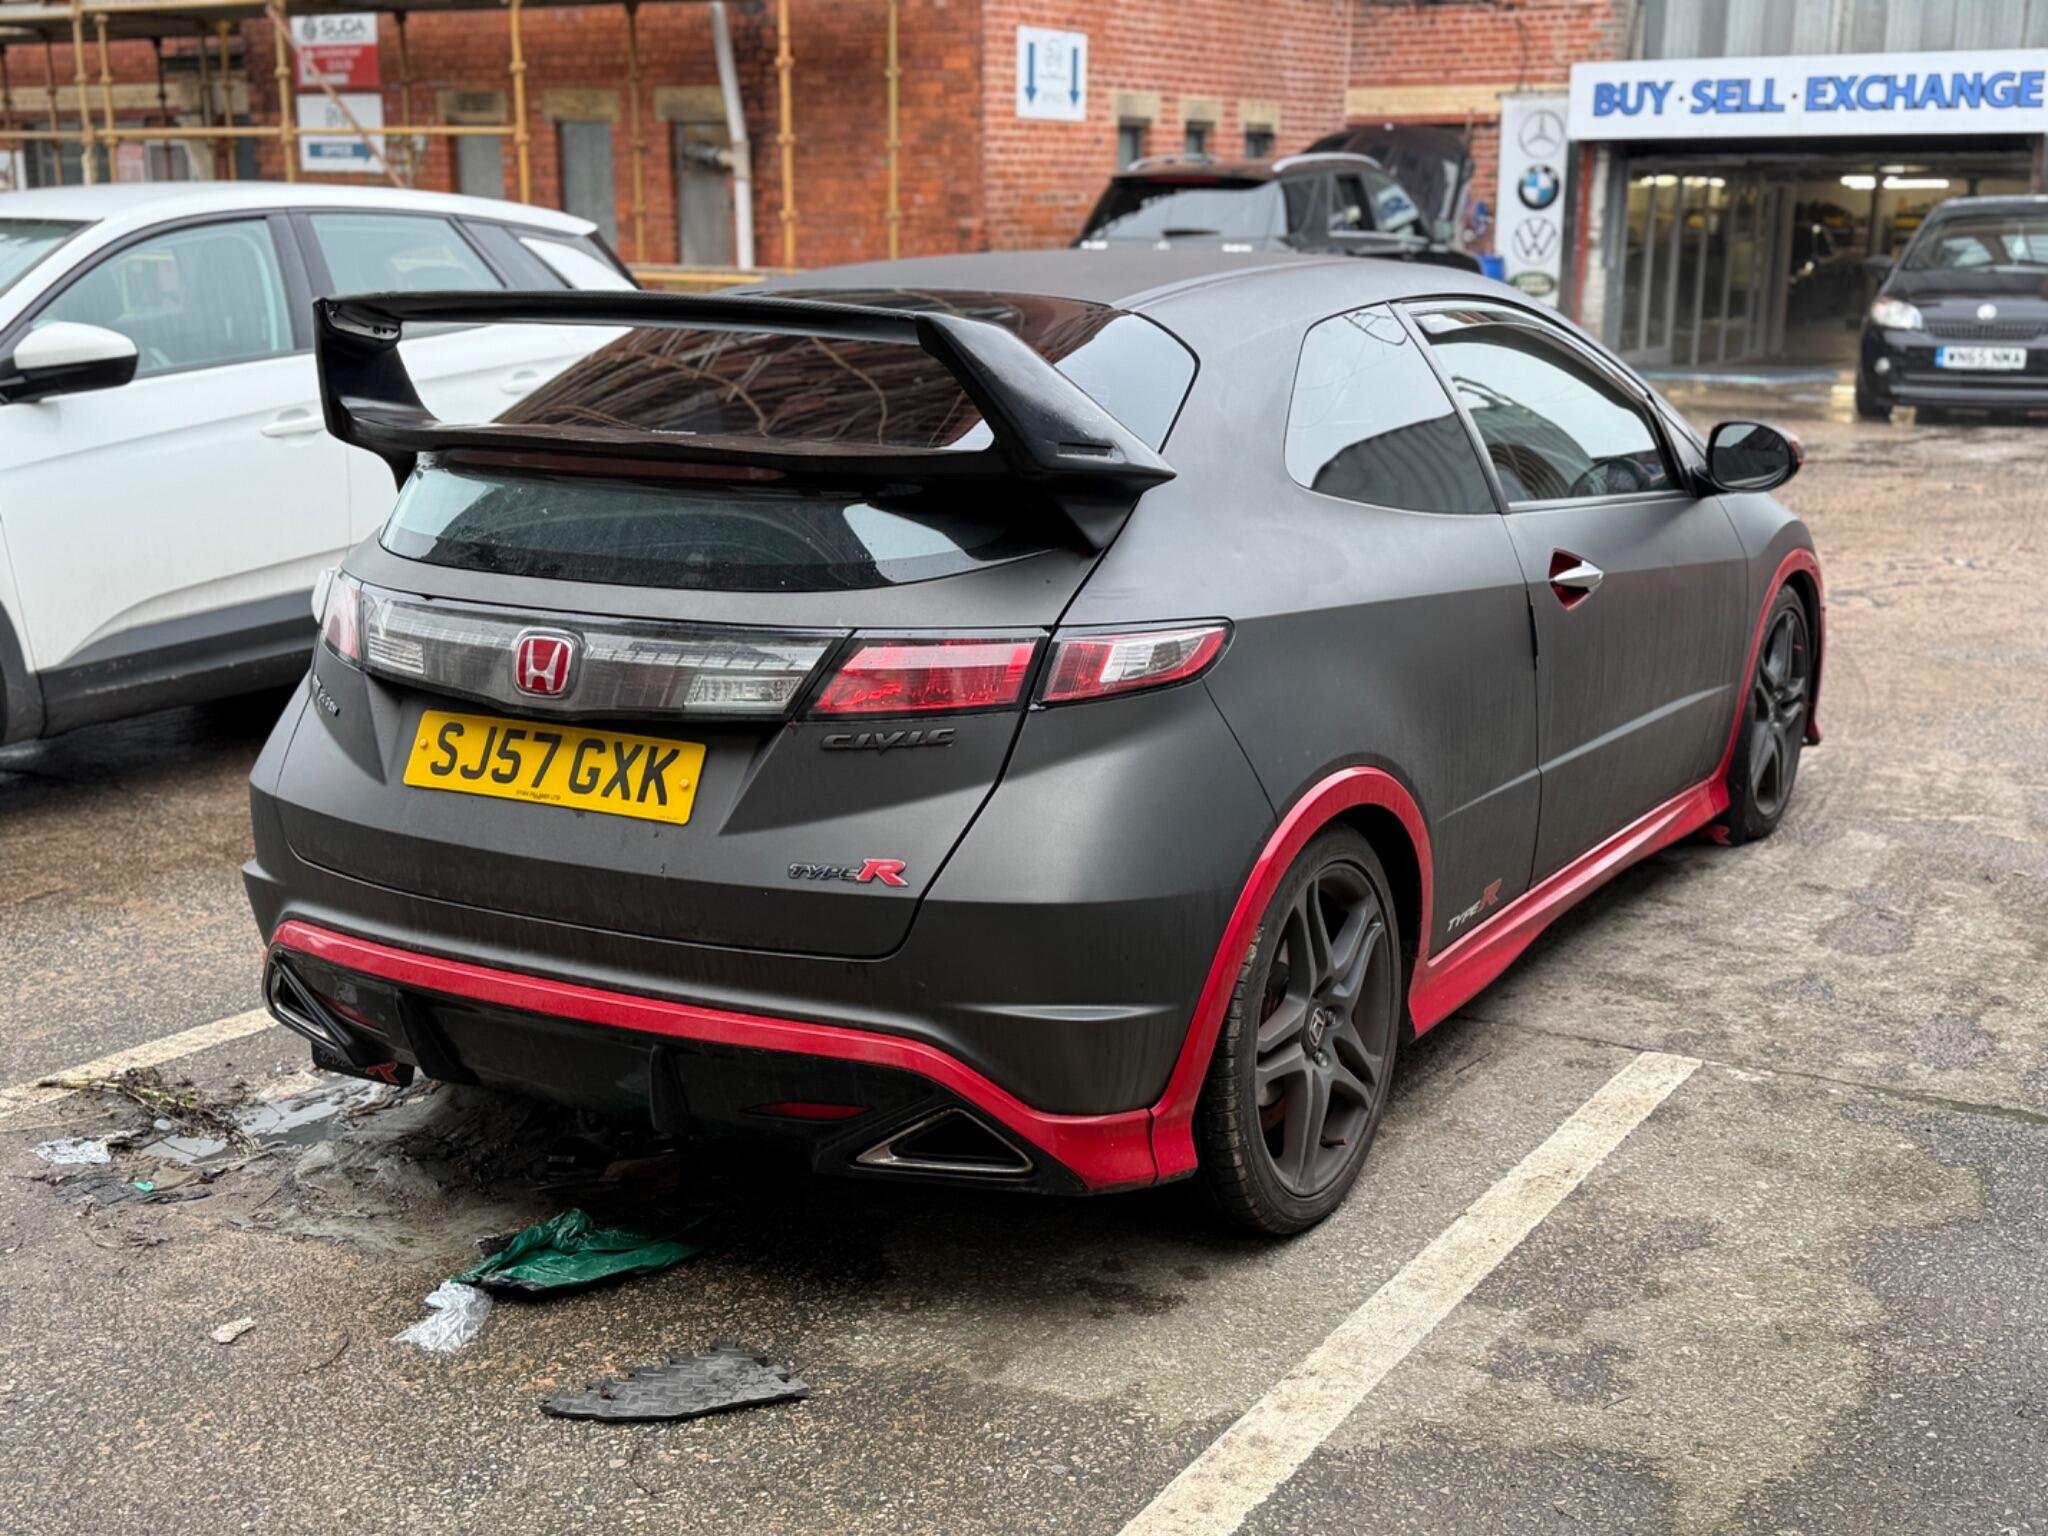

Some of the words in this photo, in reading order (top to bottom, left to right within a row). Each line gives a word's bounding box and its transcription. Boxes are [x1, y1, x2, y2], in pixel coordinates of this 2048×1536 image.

[1593, 81, 1674, 117] BUY
[1689, 78, 1785, 114] SELL
[1805, 70, 2045, 111] EXCHANGE
[430, 721, 563, 789] SJ57
[568, 738, 681, 807] GXK
[821, 728, 955, 756] CIVIC
